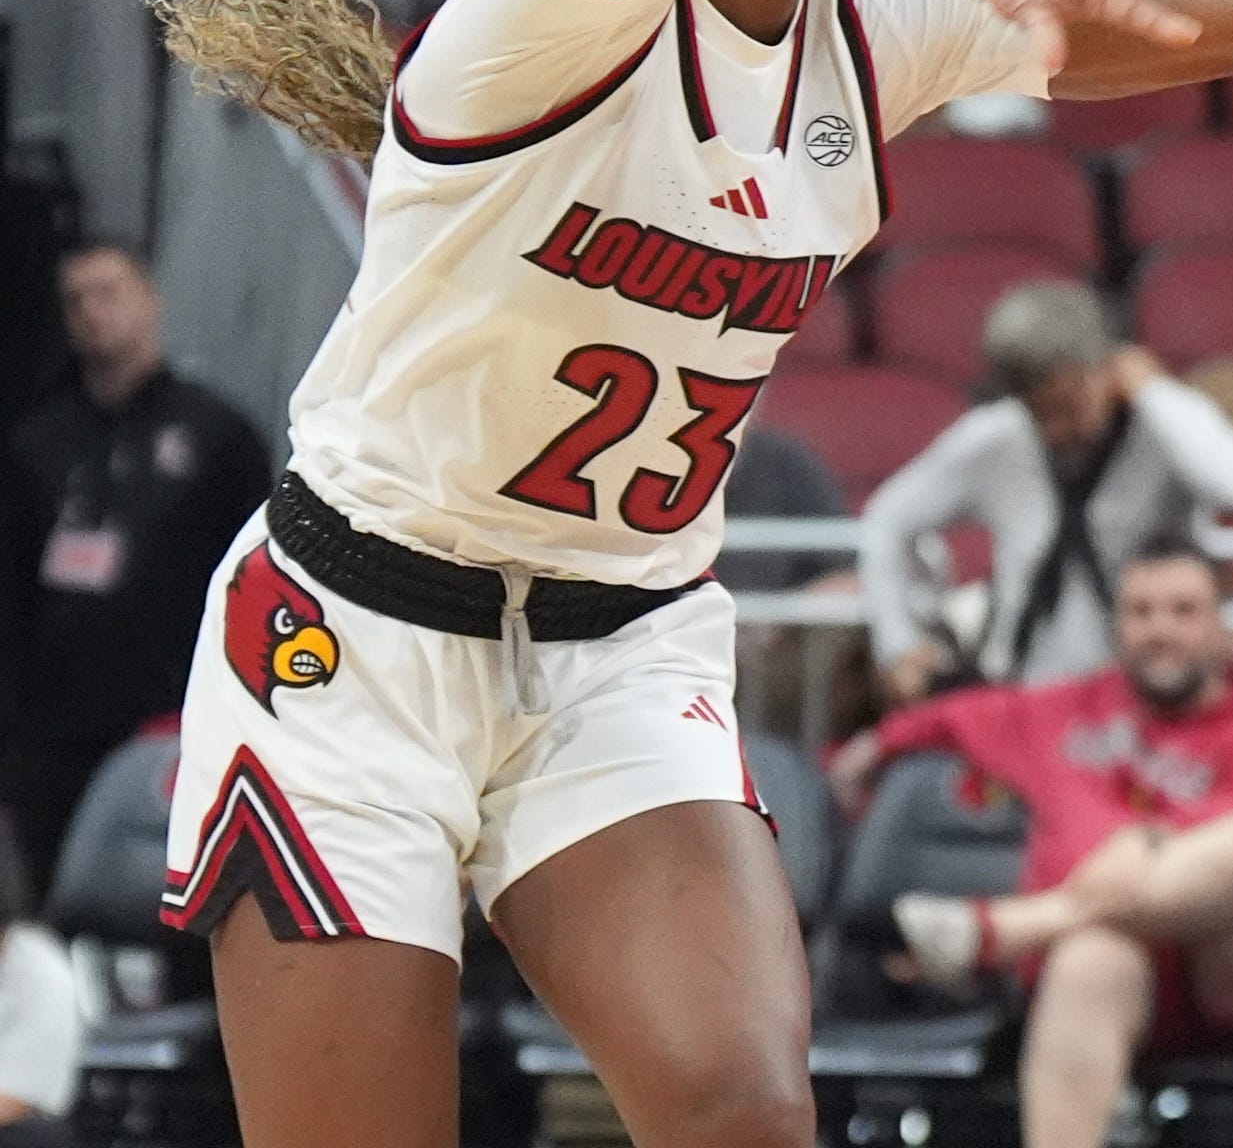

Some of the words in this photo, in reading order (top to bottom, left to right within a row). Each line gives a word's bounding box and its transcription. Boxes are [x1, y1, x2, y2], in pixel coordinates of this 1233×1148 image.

[810, 131, 853, 144] ACC
[520, 201, 846, 339] LOUISVILL
[496, 343, 770, 534] 23
